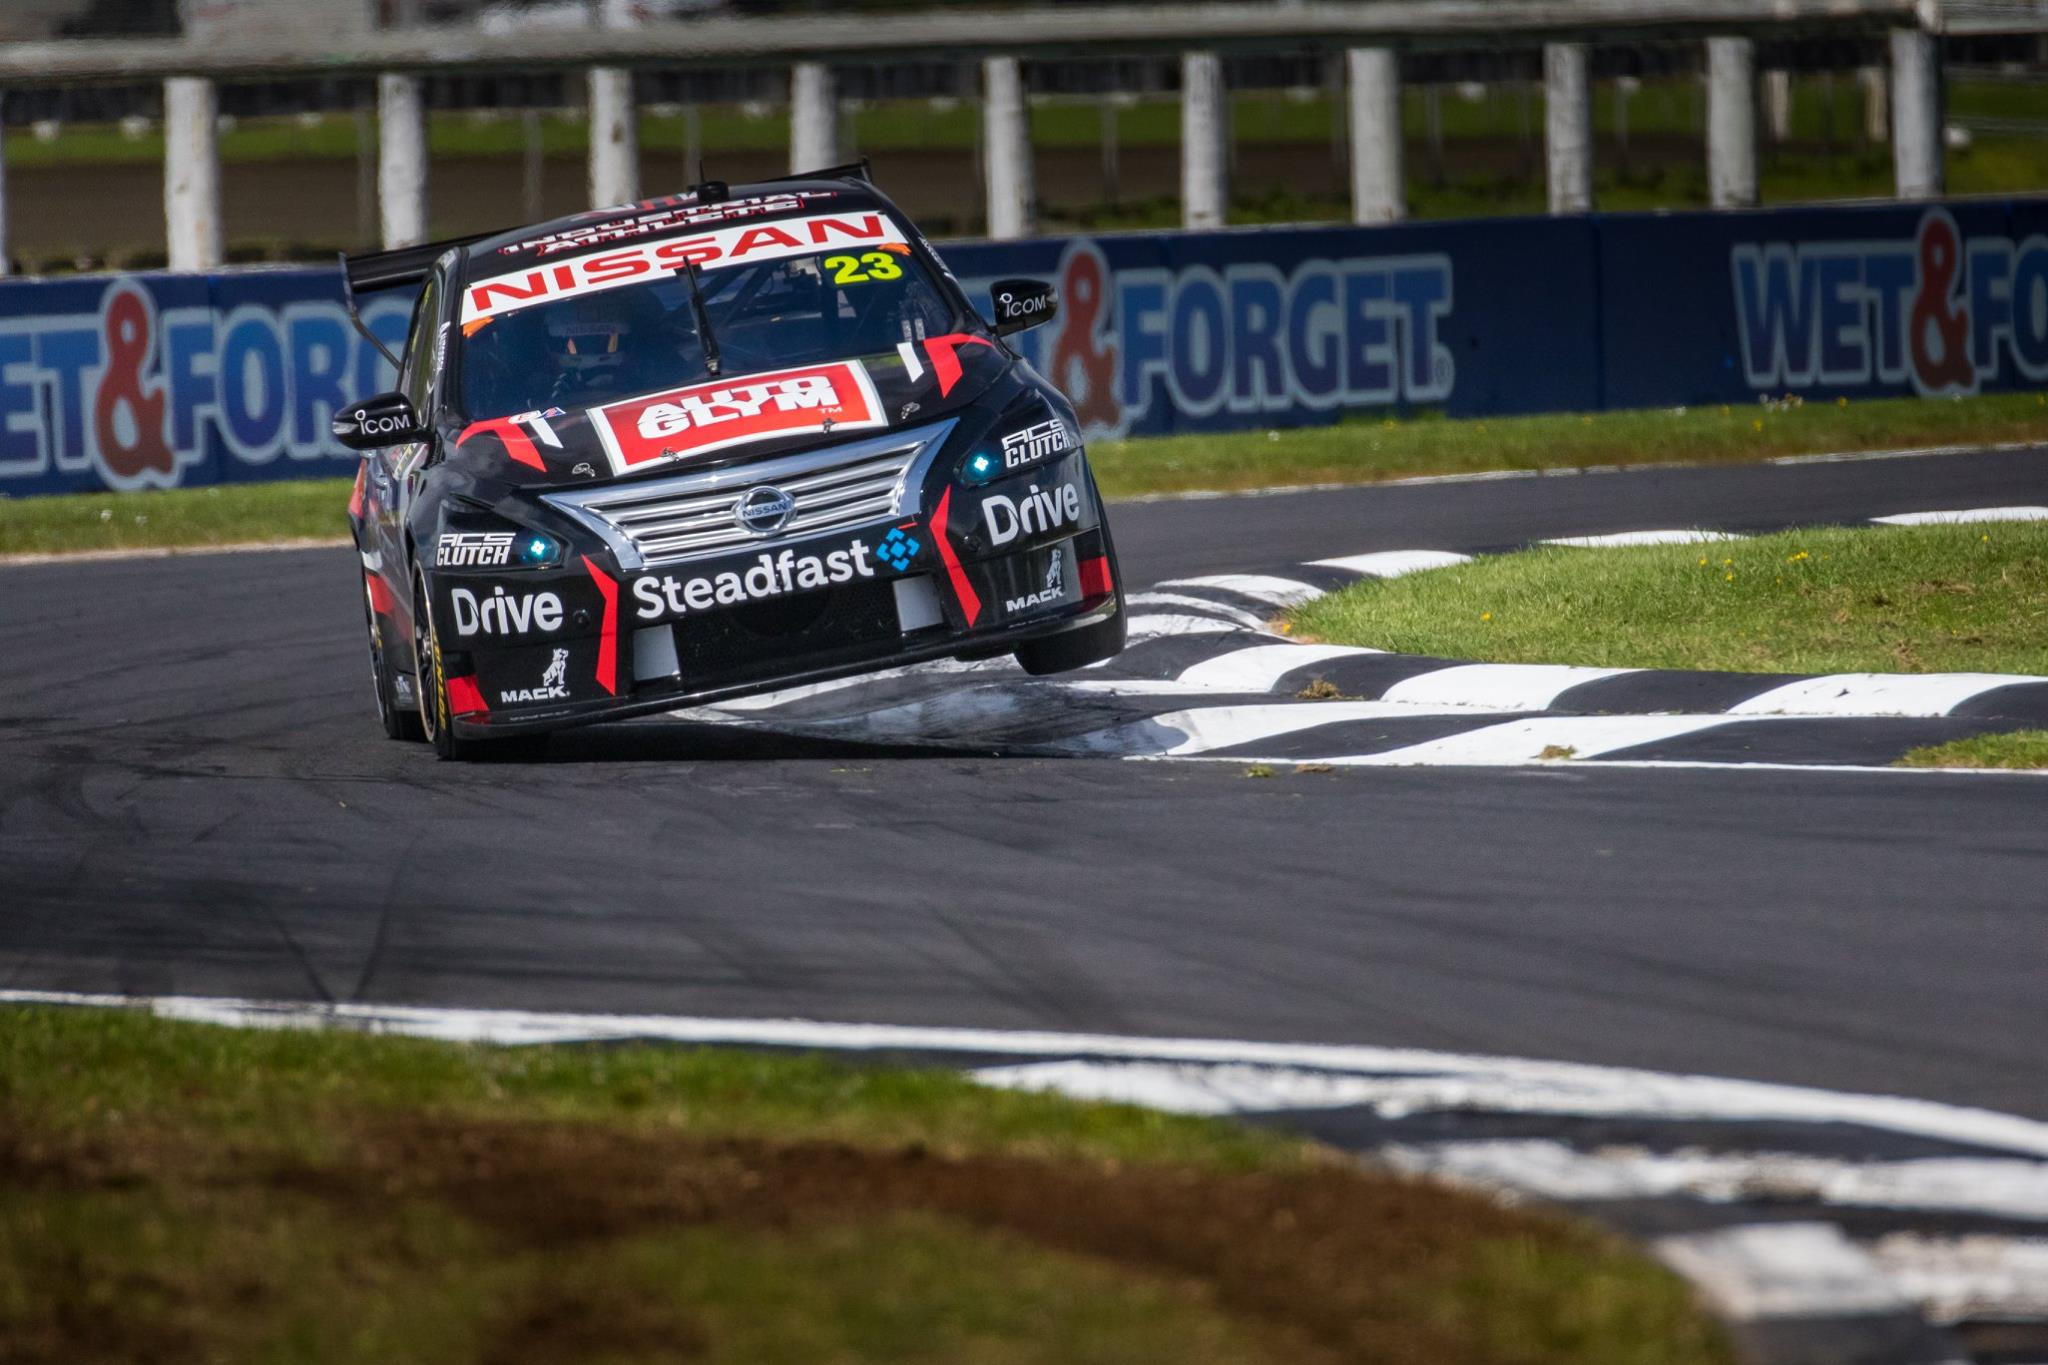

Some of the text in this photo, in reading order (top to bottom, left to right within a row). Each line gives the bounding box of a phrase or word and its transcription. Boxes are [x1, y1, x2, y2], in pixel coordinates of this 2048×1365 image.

[471, 216, 884, 310] NISSAN
[825, 253, 903, 285] 23
[1733, 243, 1914, 385] WET
[1116, 254, 1452, 415] FORGET
[1001, 418, 1064, 450] ACS
[1005, 430, 1071, 468] CLUTCH
[742, 502, 788, 518] NISSAN
[983, 483, 1080, 546] Drive
[436, 546, 510, 566] CLUTCH
[438, 532, 517, 547] ACS
[633, 539, 874, 619] Steadfast
[451, 586, 563, 635] Drive
[1007, 585, 1064, 613] MACK
[501, 686, 568, 702] MACK
